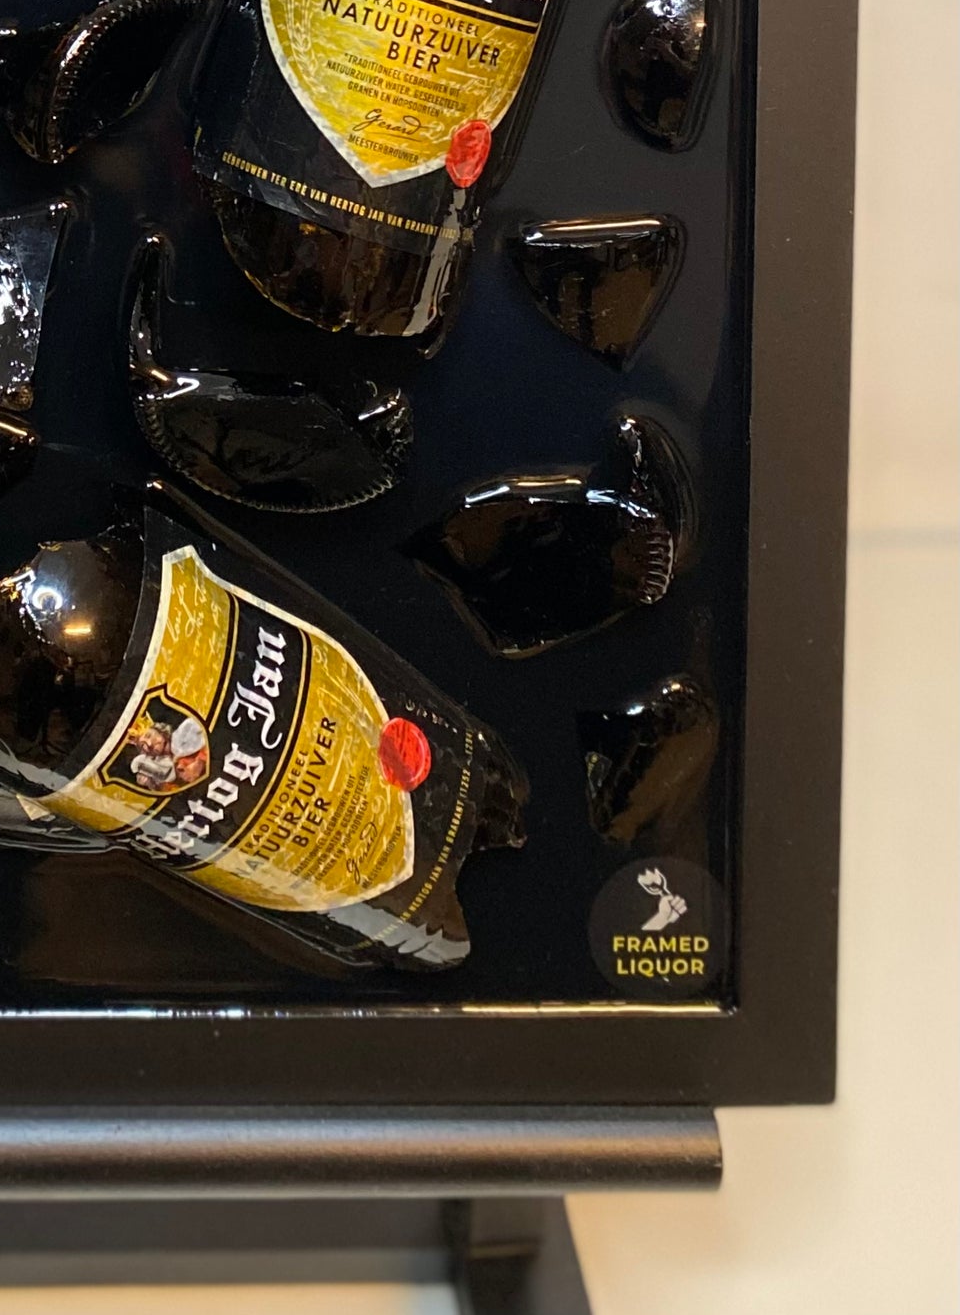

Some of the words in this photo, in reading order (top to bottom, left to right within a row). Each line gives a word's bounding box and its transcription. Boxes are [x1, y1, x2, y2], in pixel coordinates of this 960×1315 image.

[326, 59, 385, 86] NATUURZUIVER
[386, 40, 441, 74] BIER
[347, 81, 379, 99] GRANEN
[380, 91, 391, 103] EN
[403, 72, 448, 95] GEBROUWEN
[348, 133, 419, 164] MEESTERBROUWER
[222, 151, 269, 180] GEBROUWEN
[270, 171, 288, 188] TER
[310, 188, 328, 203] VAN
[330, 195, 366, 216] HERTOG
[367, 208, 385, 222] JAN
[387, 213, 404, 228] VAN
[405, 219, 439, 237] BRABANT
[227, 626, 287, 750] Jan
[239, 750, 309, 855] TRADITIONEEL
[292, 797, 333, 848] BIER
[612, 936, 709, 953] FRAMED
[616, 958, 705, 978] LIQUOR
